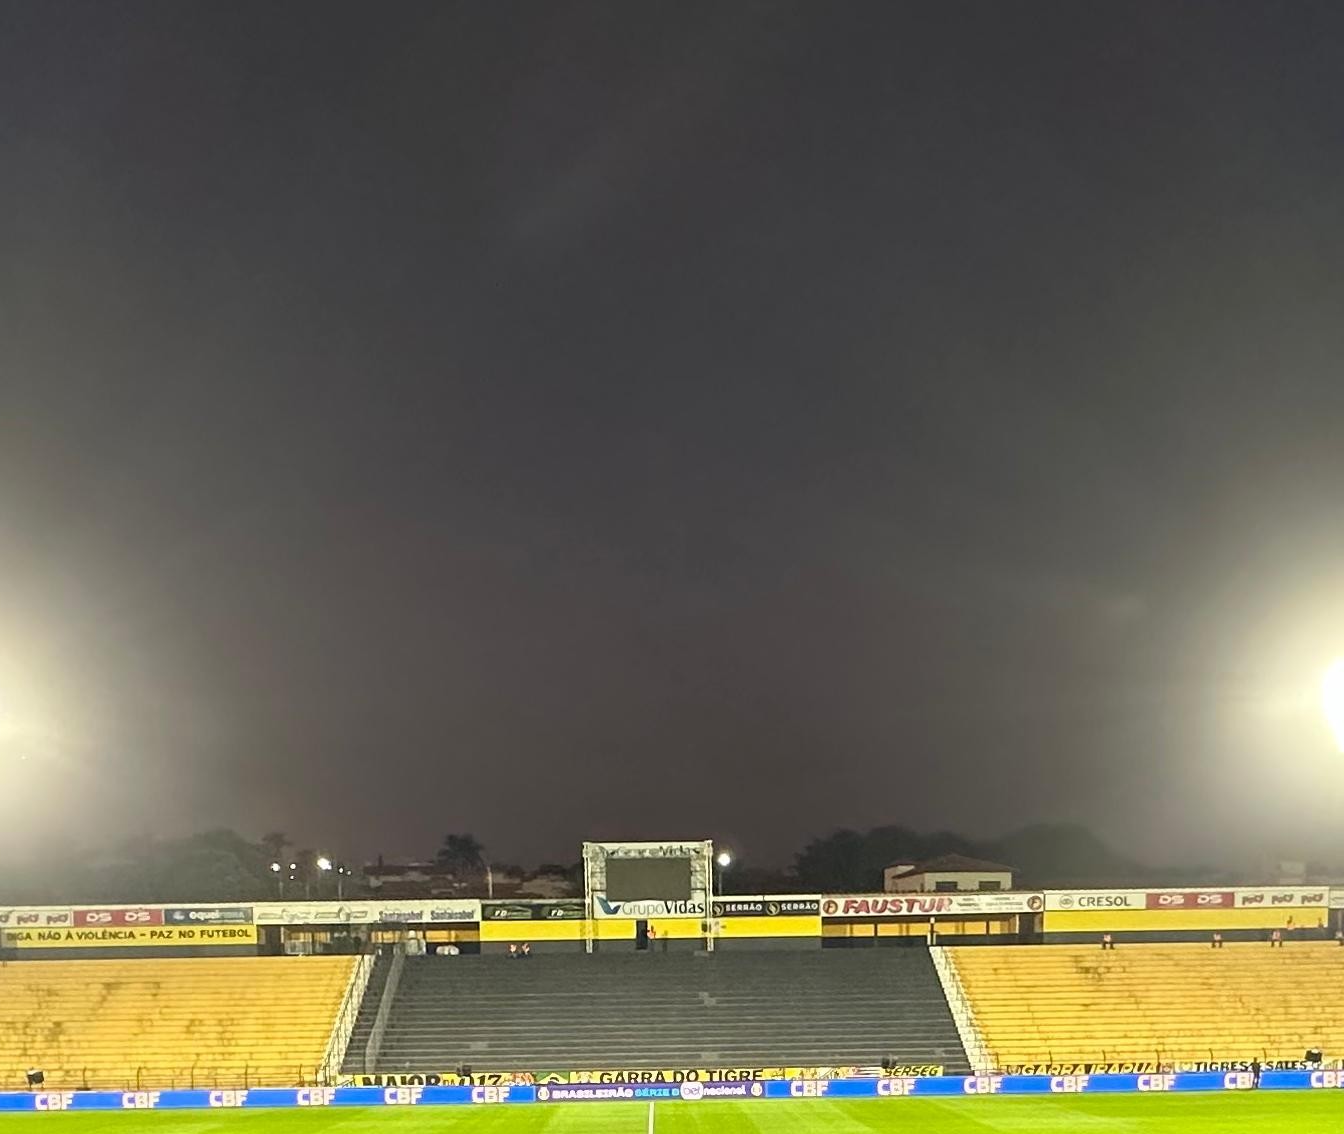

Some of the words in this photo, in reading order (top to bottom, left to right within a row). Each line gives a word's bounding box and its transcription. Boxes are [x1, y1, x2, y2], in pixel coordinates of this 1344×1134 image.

[842, 896, 954, 914] FAUSTUR
[1078, 895, 1131, 907] CRESOL
[150, 930, 173, 939] PAZ
[179, 930, 195, 939] NO
[200, 929, 252, 938] FUTEBOL
[599, 1071, 666, 1084] GARRA
[672, 1069, 700, 1083] DO
[705, 1068, 764, 1082] TIGRE
[1050, 1075, 1090, 1093] CBF
[1137, 1073, 1177, 1091] CBF
[790, 1080, 829, 1097] CBF
[877, 1078, 916, 1096] CBF
[963, 1077, 1003, 1094] CBF
[35, 1094, 74, 1111] CBF
[122, 1092, 161, 1109] CBF
[209, 1090, 249, 1108] CBF
[297, 1088, 336, 1106] CBF
[384, 1087, 423, 1105] CBF
[471, 1086, 511, 1103] CBF
